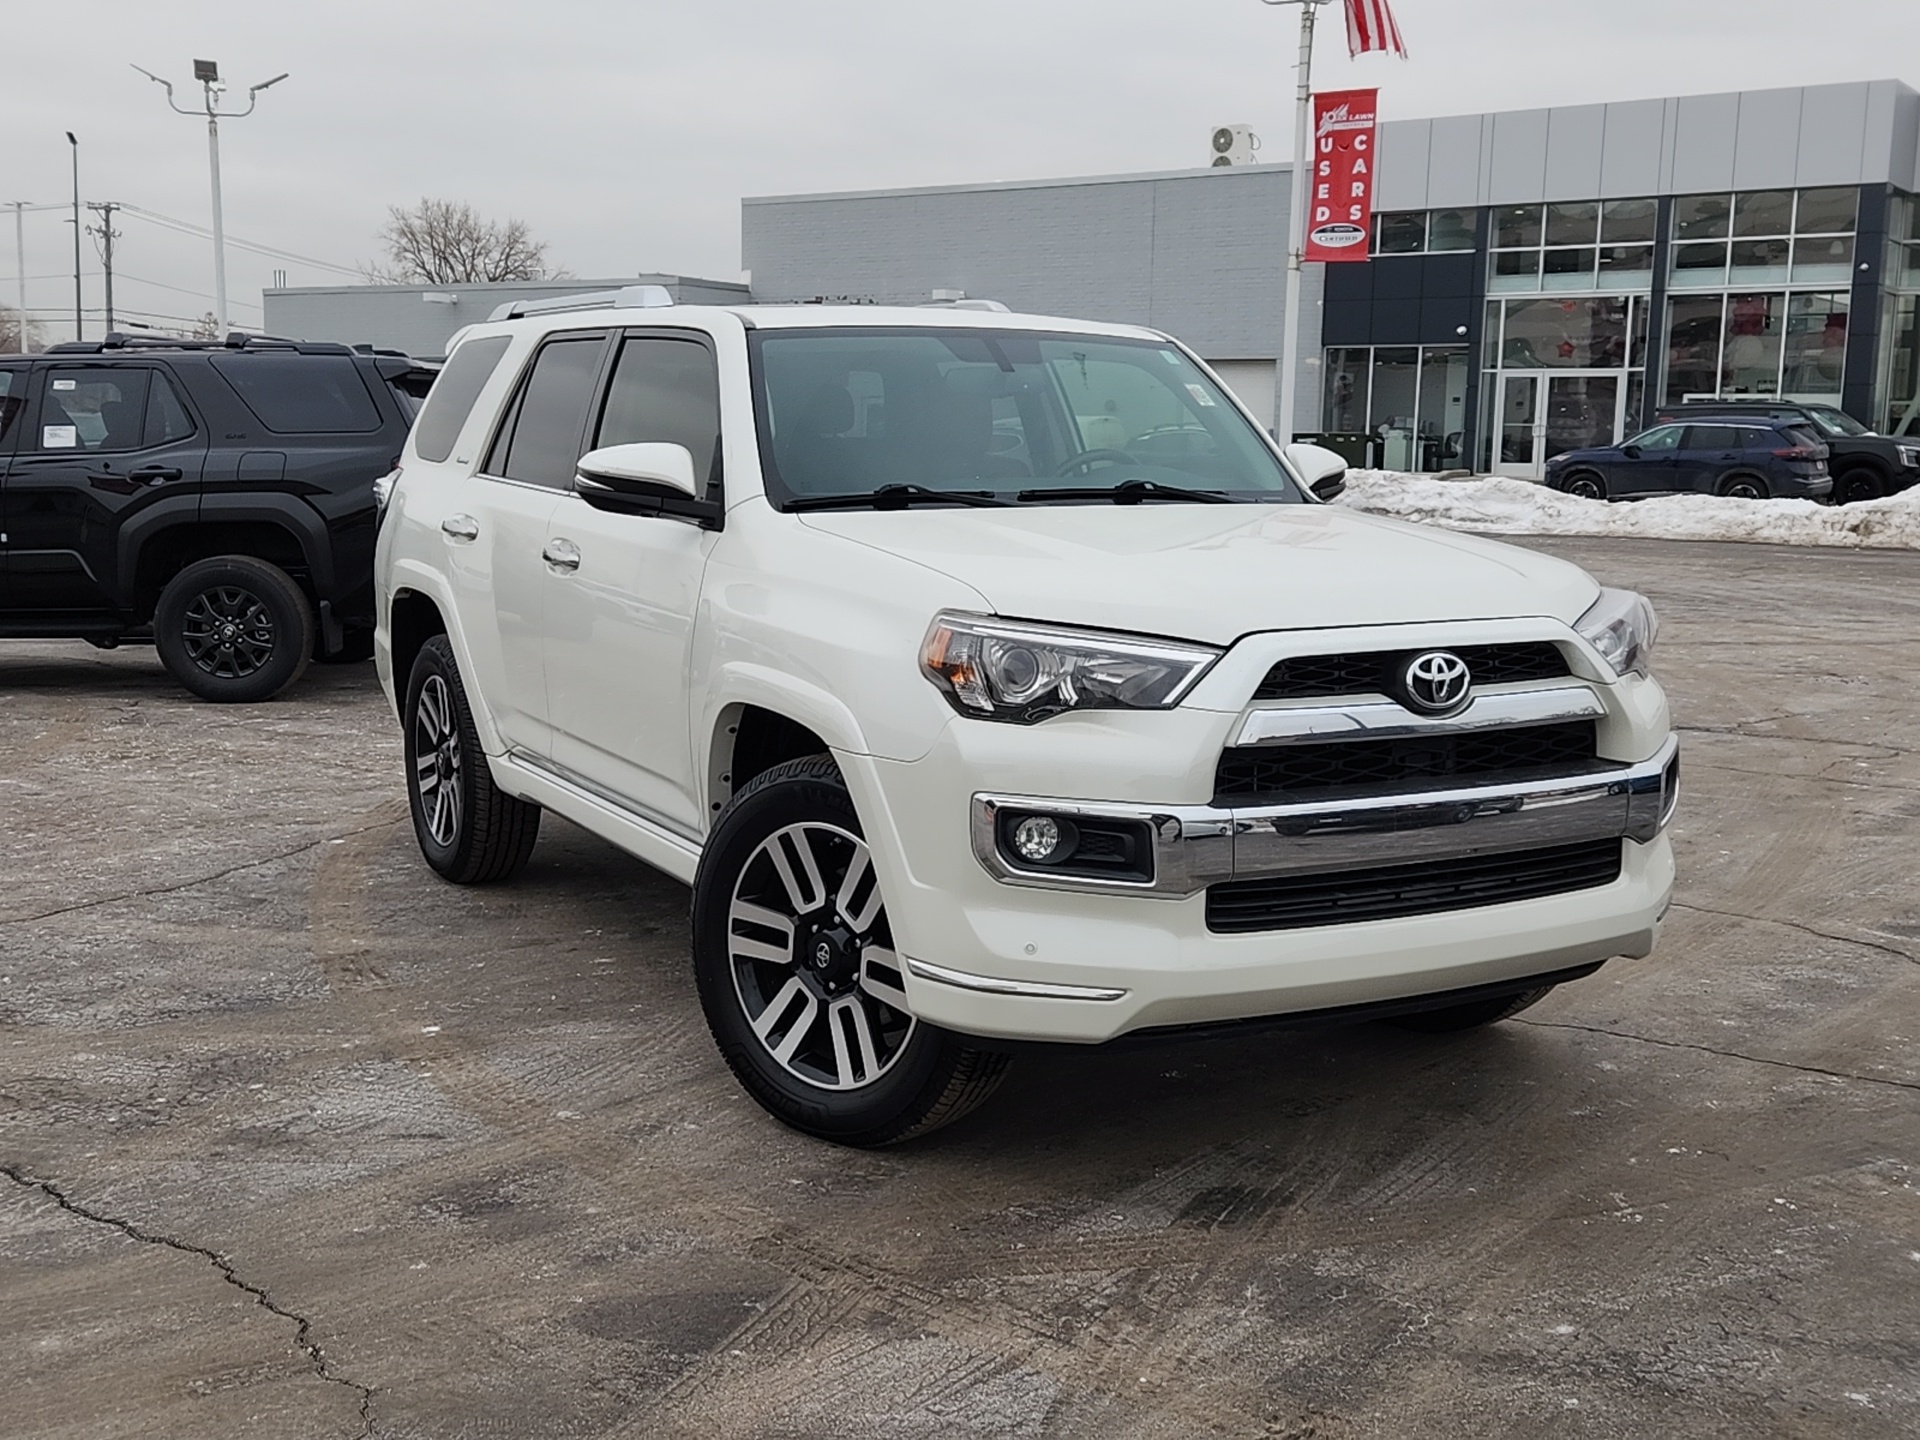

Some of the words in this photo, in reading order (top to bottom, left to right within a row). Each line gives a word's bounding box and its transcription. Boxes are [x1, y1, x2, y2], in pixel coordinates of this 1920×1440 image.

[1348, 112, 1375, 121] LAWN
[1315, 136, 1334, 222] USED
[1350, 134, 1369, 221] CARS
